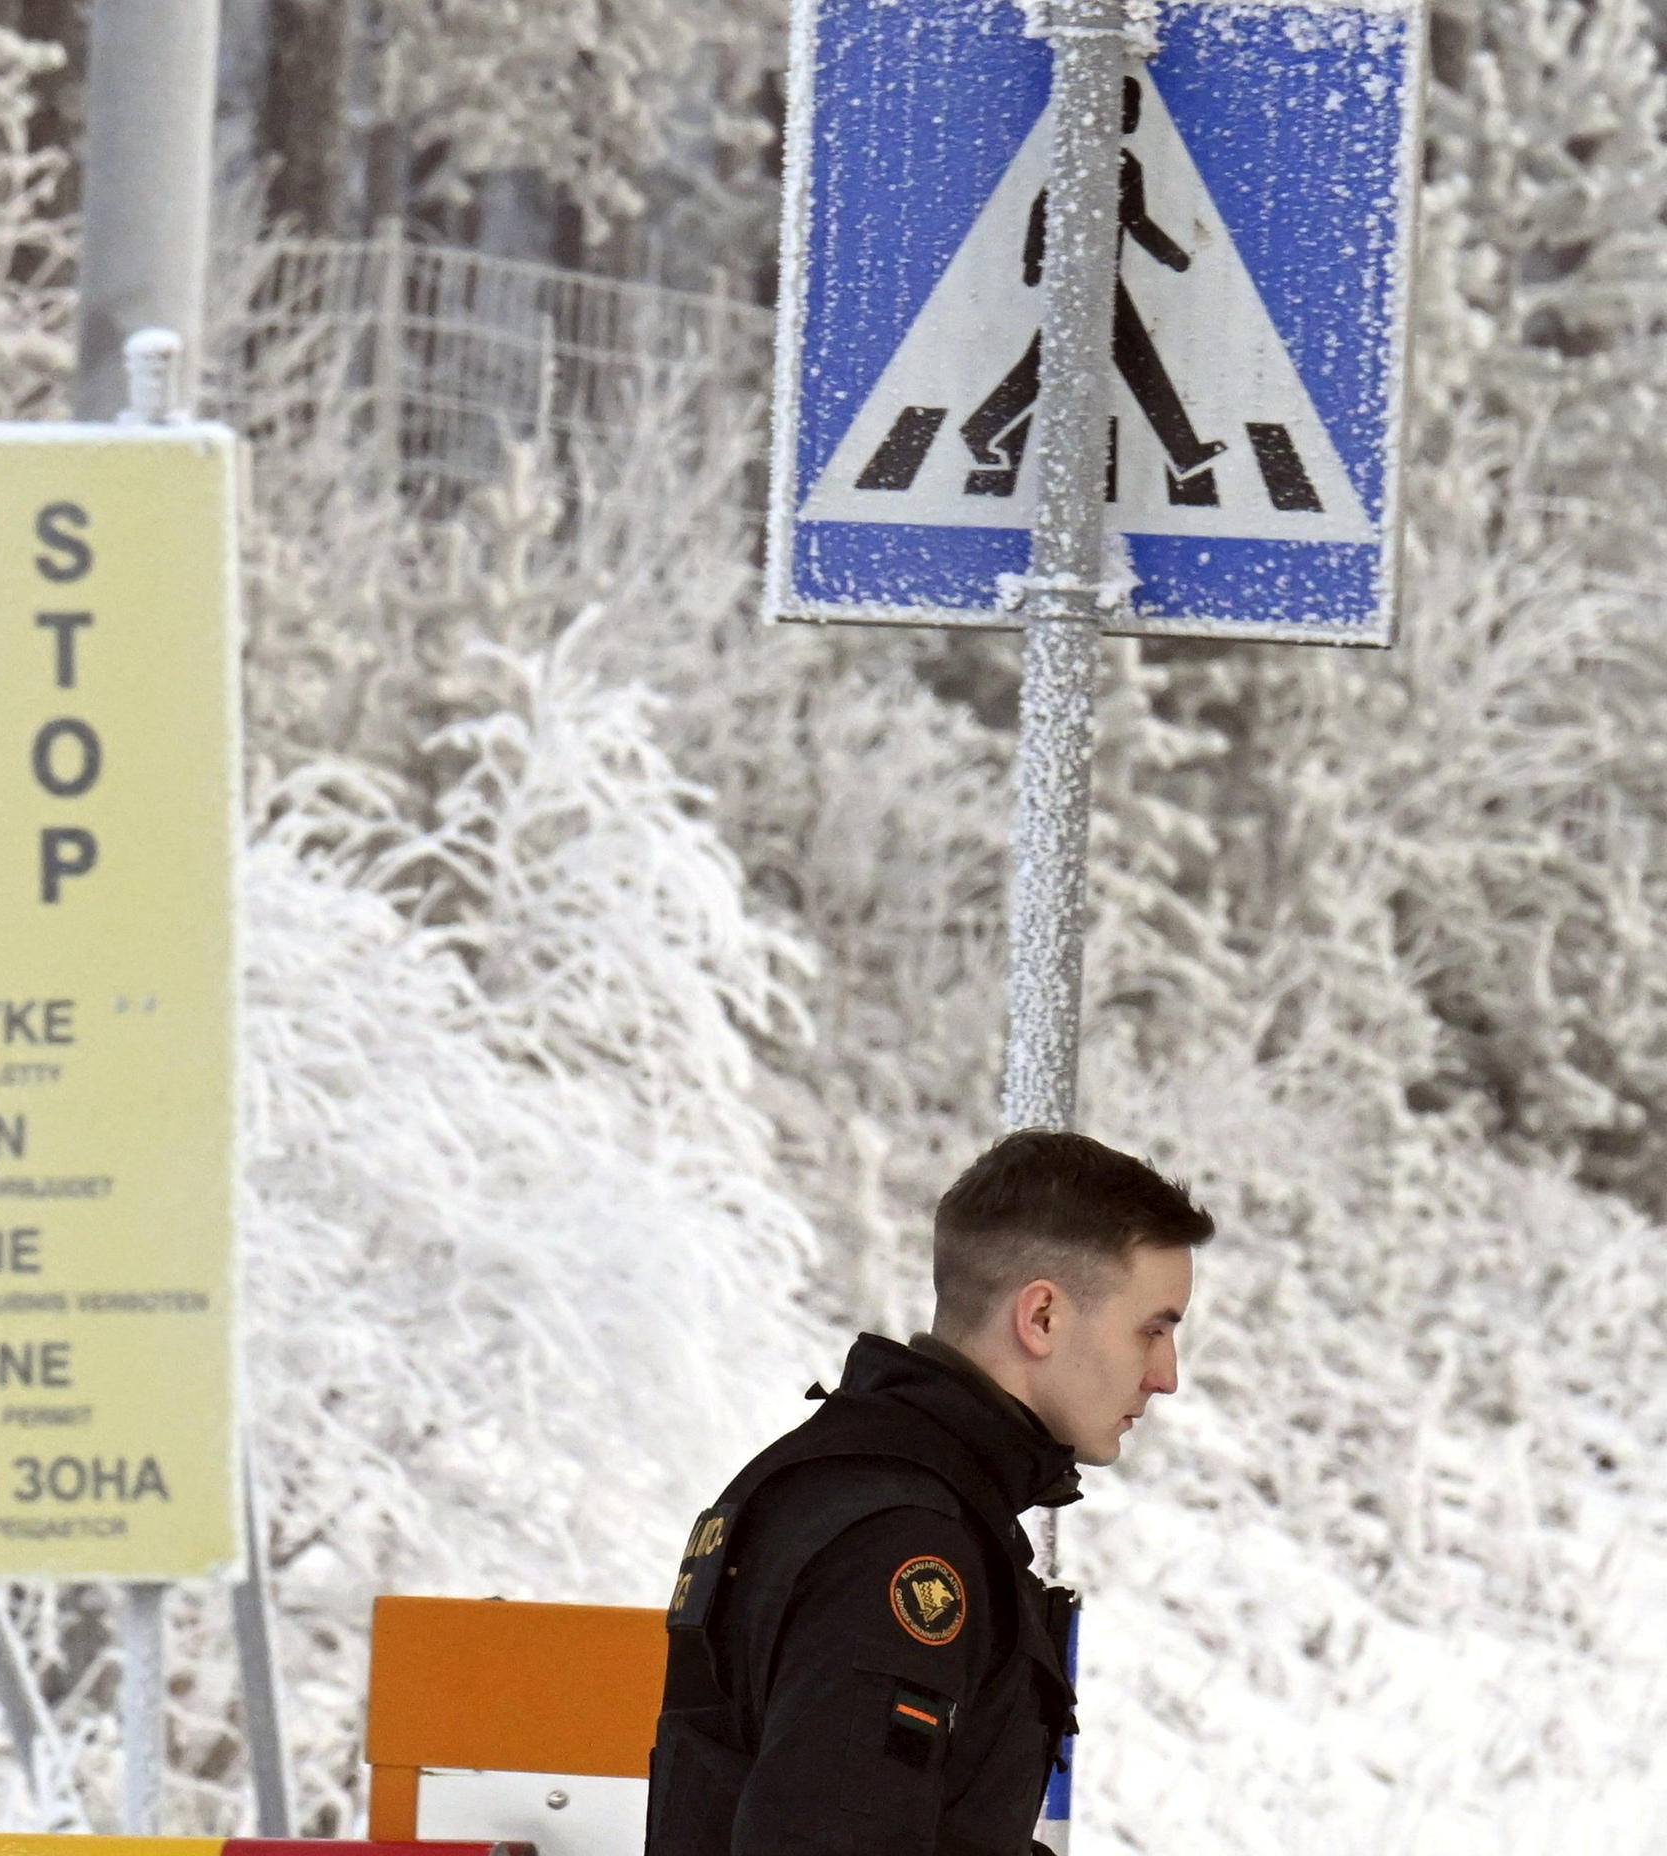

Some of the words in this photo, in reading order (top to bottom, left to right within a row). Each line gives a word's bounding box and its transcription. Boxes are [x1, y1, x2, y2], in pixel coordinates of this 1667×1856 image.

[31, 501, 102, 905] STOP
[1, 1405, 94, 1428] PERMIT
[13, 1456, 170, 1502] ЗОНА
